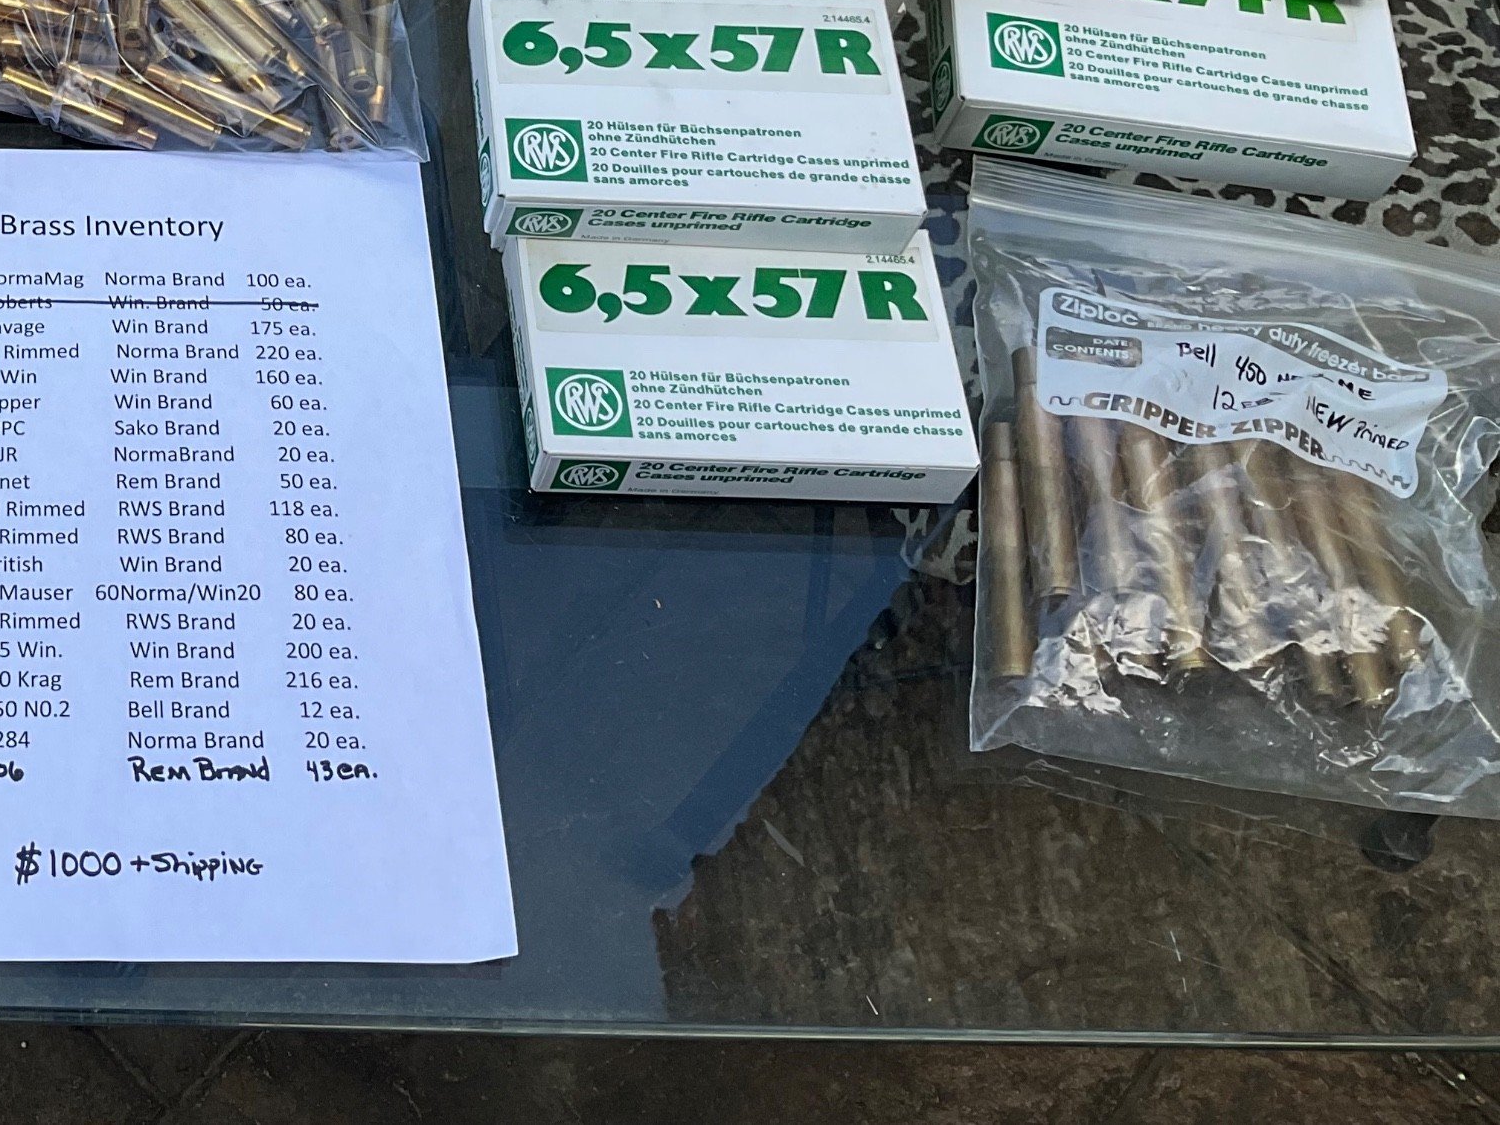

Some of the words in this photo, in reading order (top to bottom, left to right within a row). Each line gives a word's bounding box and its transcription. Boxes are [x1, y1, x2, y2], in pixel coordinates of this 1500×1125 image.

[2, 215, 76, 236] Brass
[86, 215, 224, 243] Inventory
[106, 272, 166, 286] Norma
[173, 272, 224, 287] Brand
[247, 273, 284, 288] 100
[288, 277, 311, 288] ea.
[112, 319, 148, 334] Win
[155, 319, 208, 334] Brand
[251, 321, 285, 336] 175
[290, 326, 316, 337] ea.
[1059, 295, 1140, 327] Ziploc
[1268, 325, 1309, 360] duty
[1310, 344, 1368, 377] freezer
[1176, 342, 1216, 368] Bell
[634, 400, 650, 410] 20
[654, 400, 702, 412] Center
[705, 401, 734, 413] Fire
[738, 402, 771, 414] Rifle
[775, 403, 843, 418] Cartridge
[846, 406, 889, 418] Cases
[893, 407, 961, 421] unprimed
[1083, 392, 1217, 440] GRIPPER
[1230, 418, 1326, 461] ZIPPER
[120, 556, 158, 573] Win
[166, 555, 222, 573] Brand
[289, 557, 312, 572] 20
[317, 561, 347, 573] ea.
